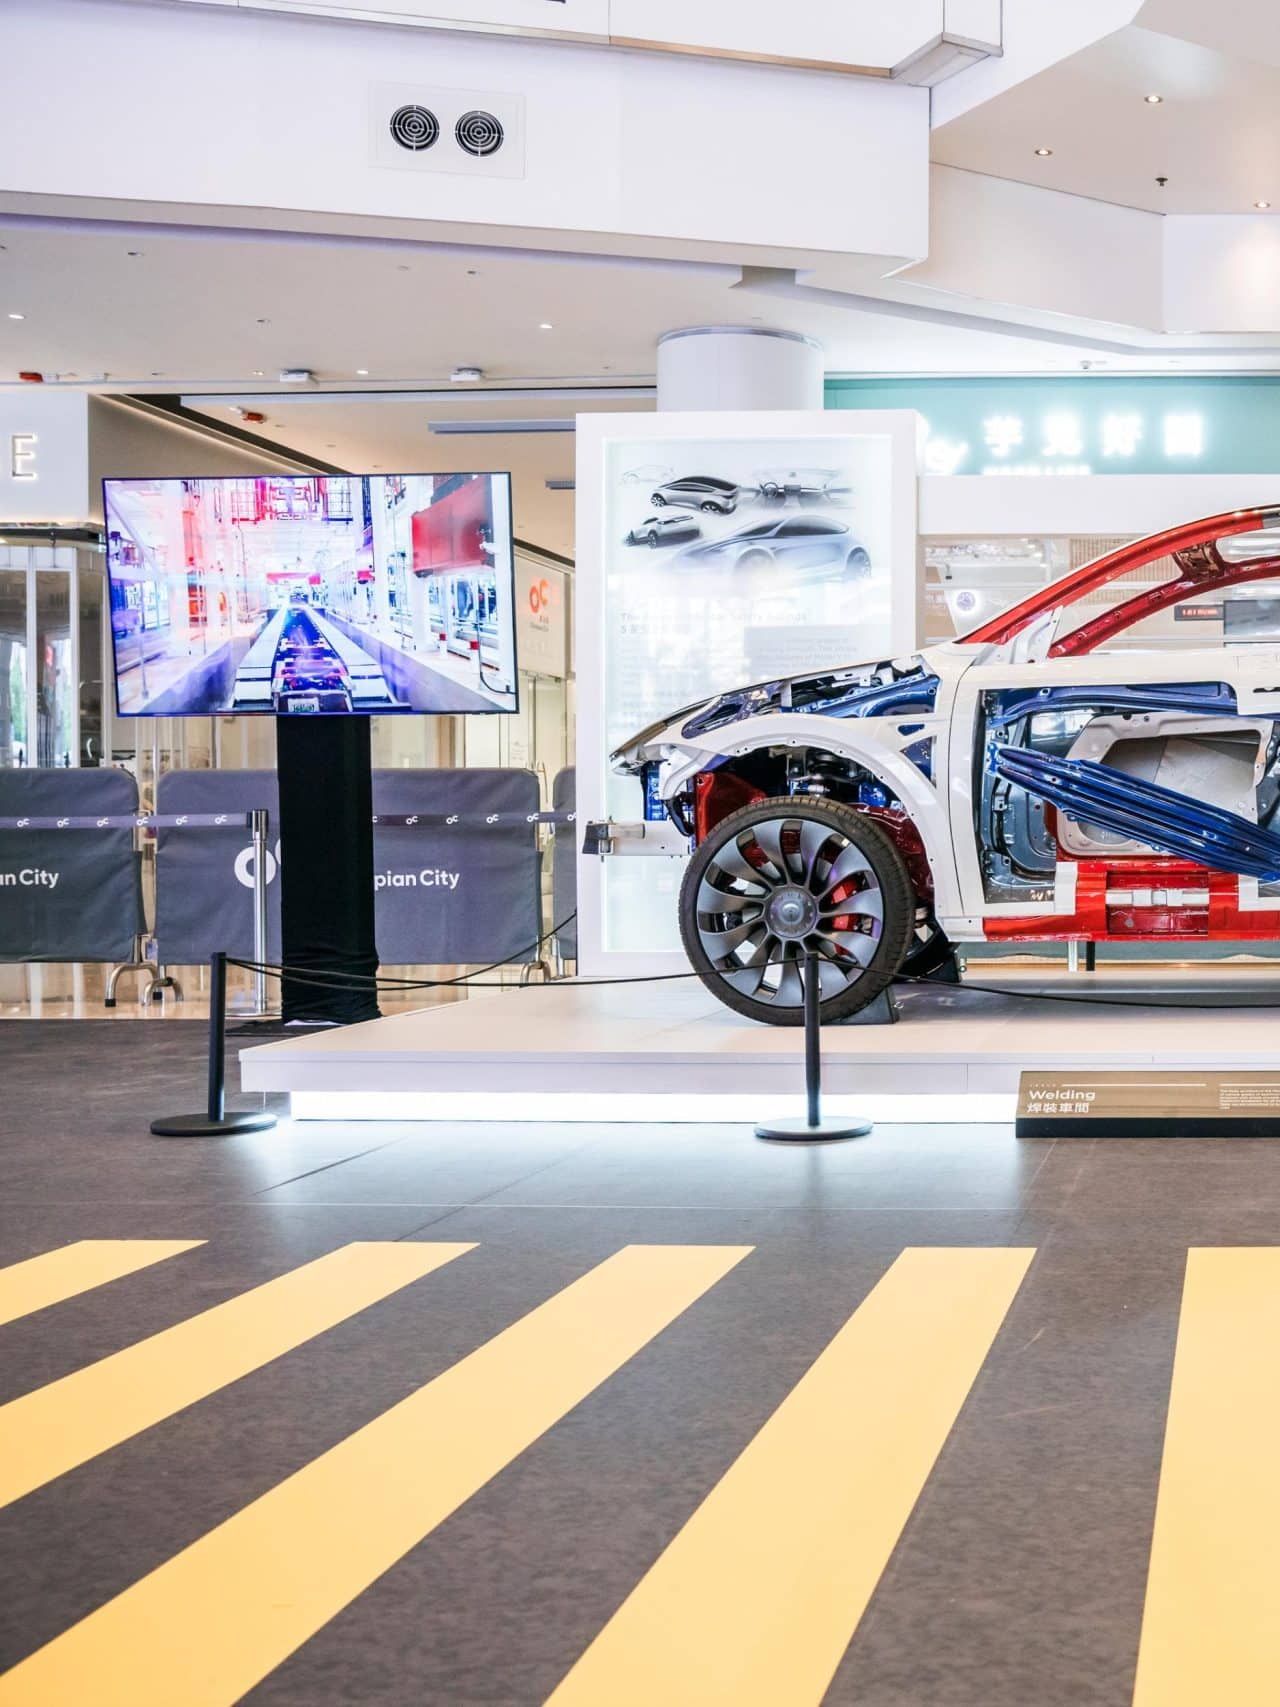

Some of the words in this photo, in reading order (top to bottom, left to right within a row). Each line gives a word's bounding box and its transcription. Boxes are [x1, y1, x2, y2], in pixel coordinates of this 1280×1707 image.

[19, 868, 59, 889] City
[420, 869, 460, 888] City
[1029, 1089, 1096, 1101] Welding
